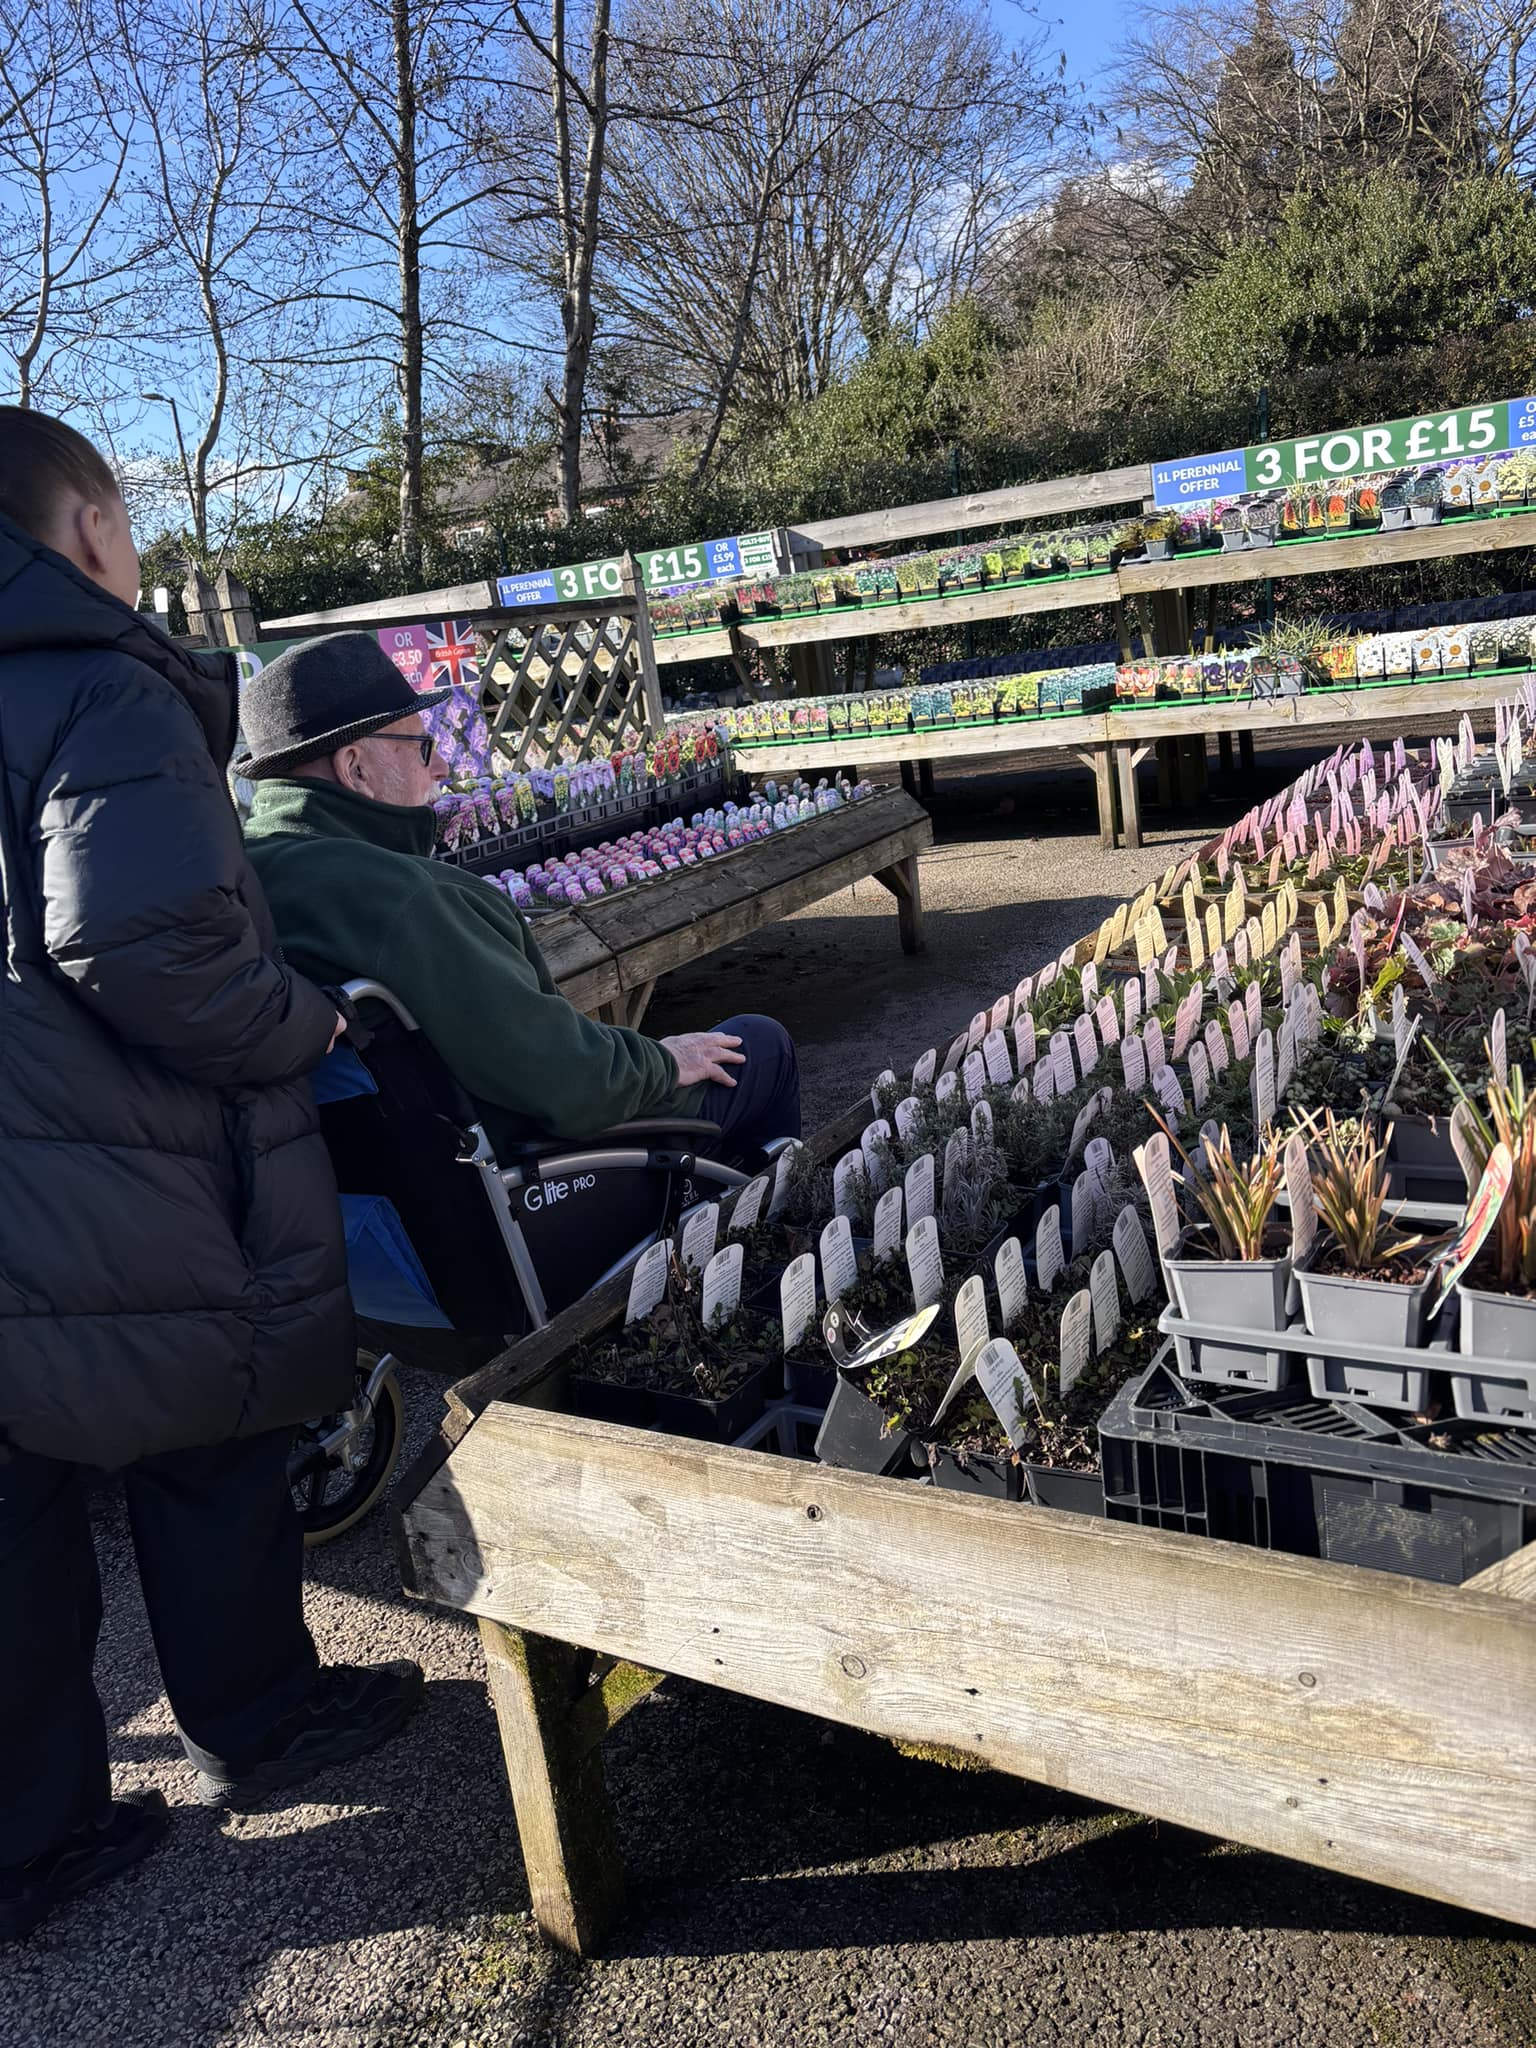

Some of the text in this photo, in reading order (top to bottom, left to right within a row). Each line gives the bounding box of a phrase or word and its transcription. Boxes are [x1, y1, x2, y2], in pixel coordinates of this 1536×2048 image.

[1526, 401, 1536, 413] O
[1255, 408, 1496, 485] 3 FOR £15
[1157, 459, 1242, 484] 1L PERENNIAL
[1179, 477, 1220, 494] OFFER
[715, 542, 729, 552] OR
[713, 551, 735, 564] £5.99
[560, 547, 702, 598] 3 FO £15
[716, 562, 736, 574] each
[510, 577, 553, 593] PERENNIAL
[516, 591, 542, 603] OFFER
[394, 631, 414, 648] OR
[391, 648, 423, 667] £3.50
[524, 1174, 596, 1211] G lite PRO
